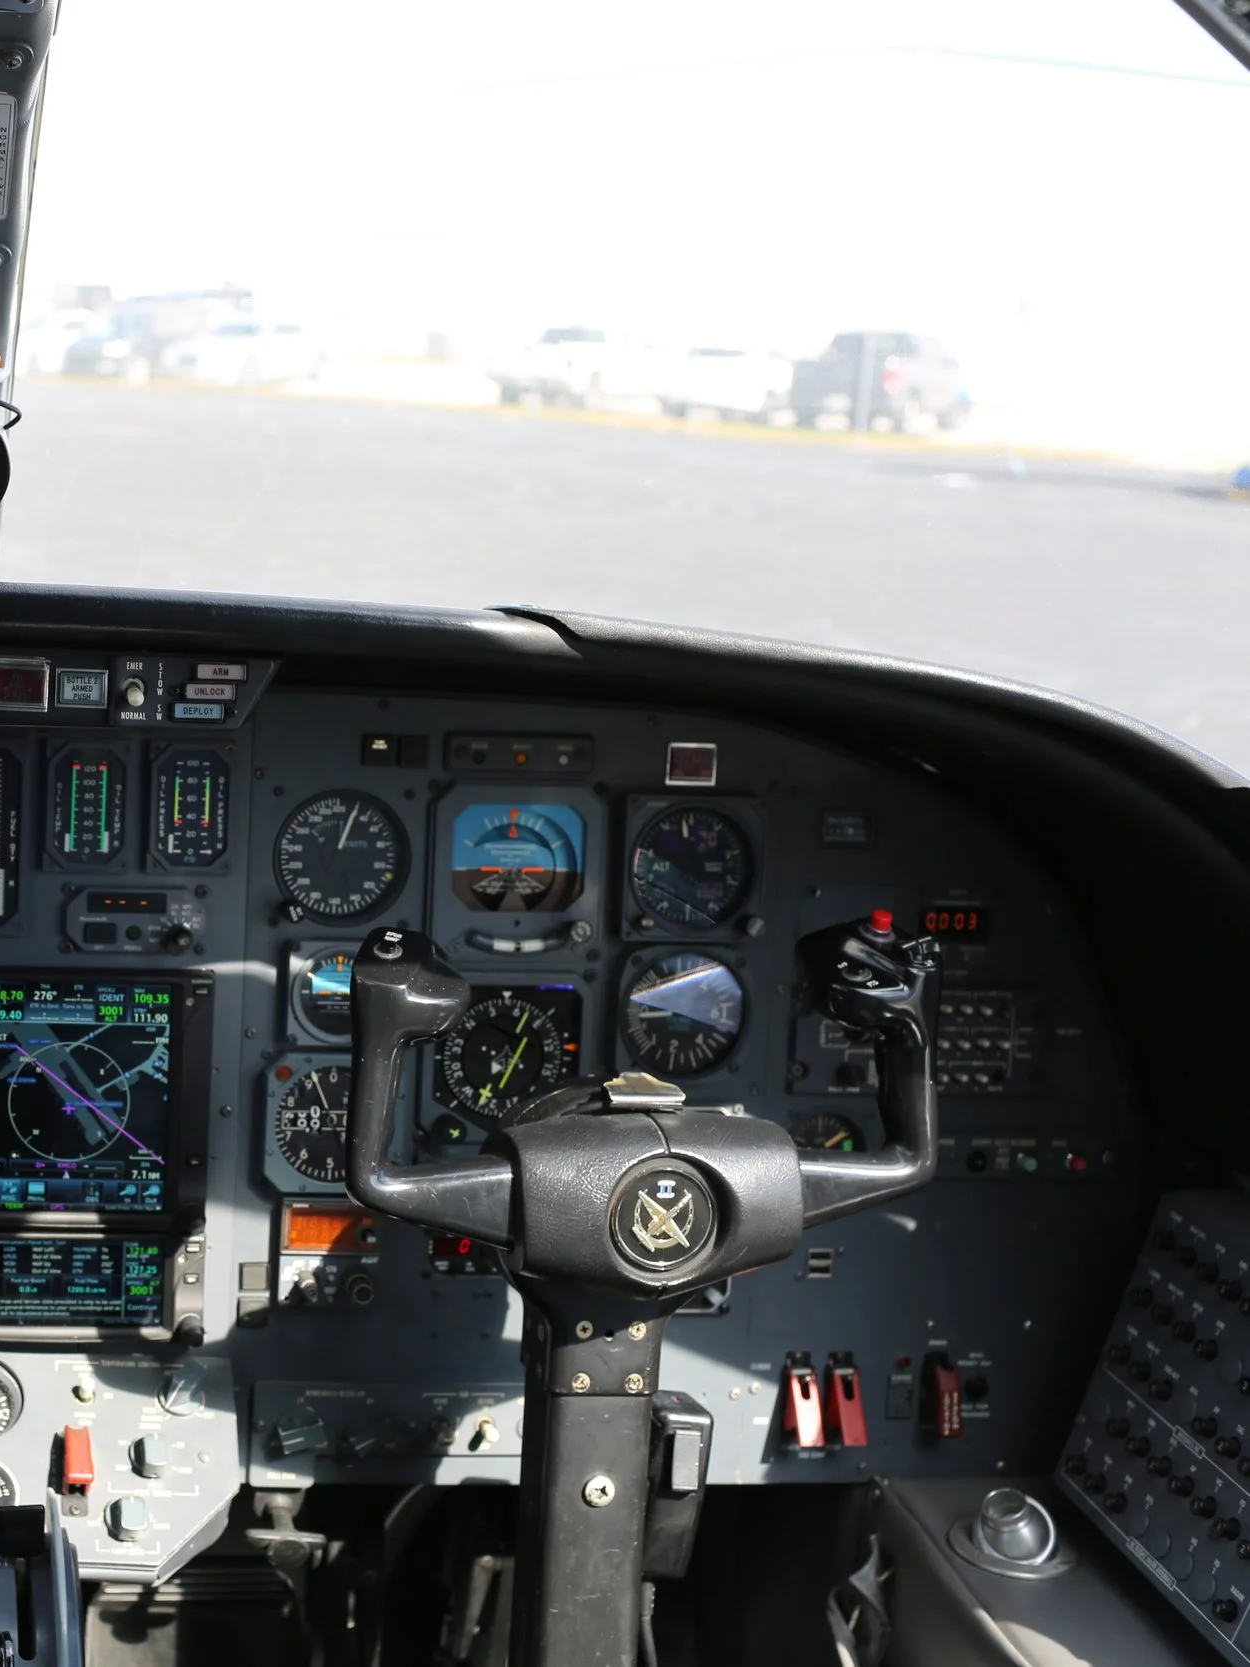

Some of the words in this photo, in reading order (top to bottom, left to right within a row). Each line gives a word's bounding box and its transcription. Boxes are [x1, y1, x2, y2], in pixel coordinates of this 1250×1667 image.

[127, 662, 143, 670] EMER
[213, 668, 228, 676] ARM
[67, 677, 91, 685] BOTTLE
[194, 688, 225, 696] UNLOCK
[73, 693, 91, 701] PUSH
[183, 707, 214, 715] DEPLOY
[121, 712, 146, 720] NORMAL
[653, 862, 670, 872] ALT
[34, 990, 57, 1000] 276°
[99, 994, 125, 1002] IDENT
[134, 994, 170, 1004] 109.35
[98, 1006, 123, 1016] 3001
[710, 1008, 720, 1019] 6
[134, 1014, 168, 1023] 111.90
[695, 1032, 704, 1044] 4
[670, 1040, 678, 1049] 2
[330, 1072, 338, 1083] 0
[305, 1079, 312, 1090] 9
[287, 1097, 294, 1107] 8
[300, 1149, 308, 1159] 6
[326, 1157, 334, 1168] 5
[131, 1171, 146, 1180] 7.1
